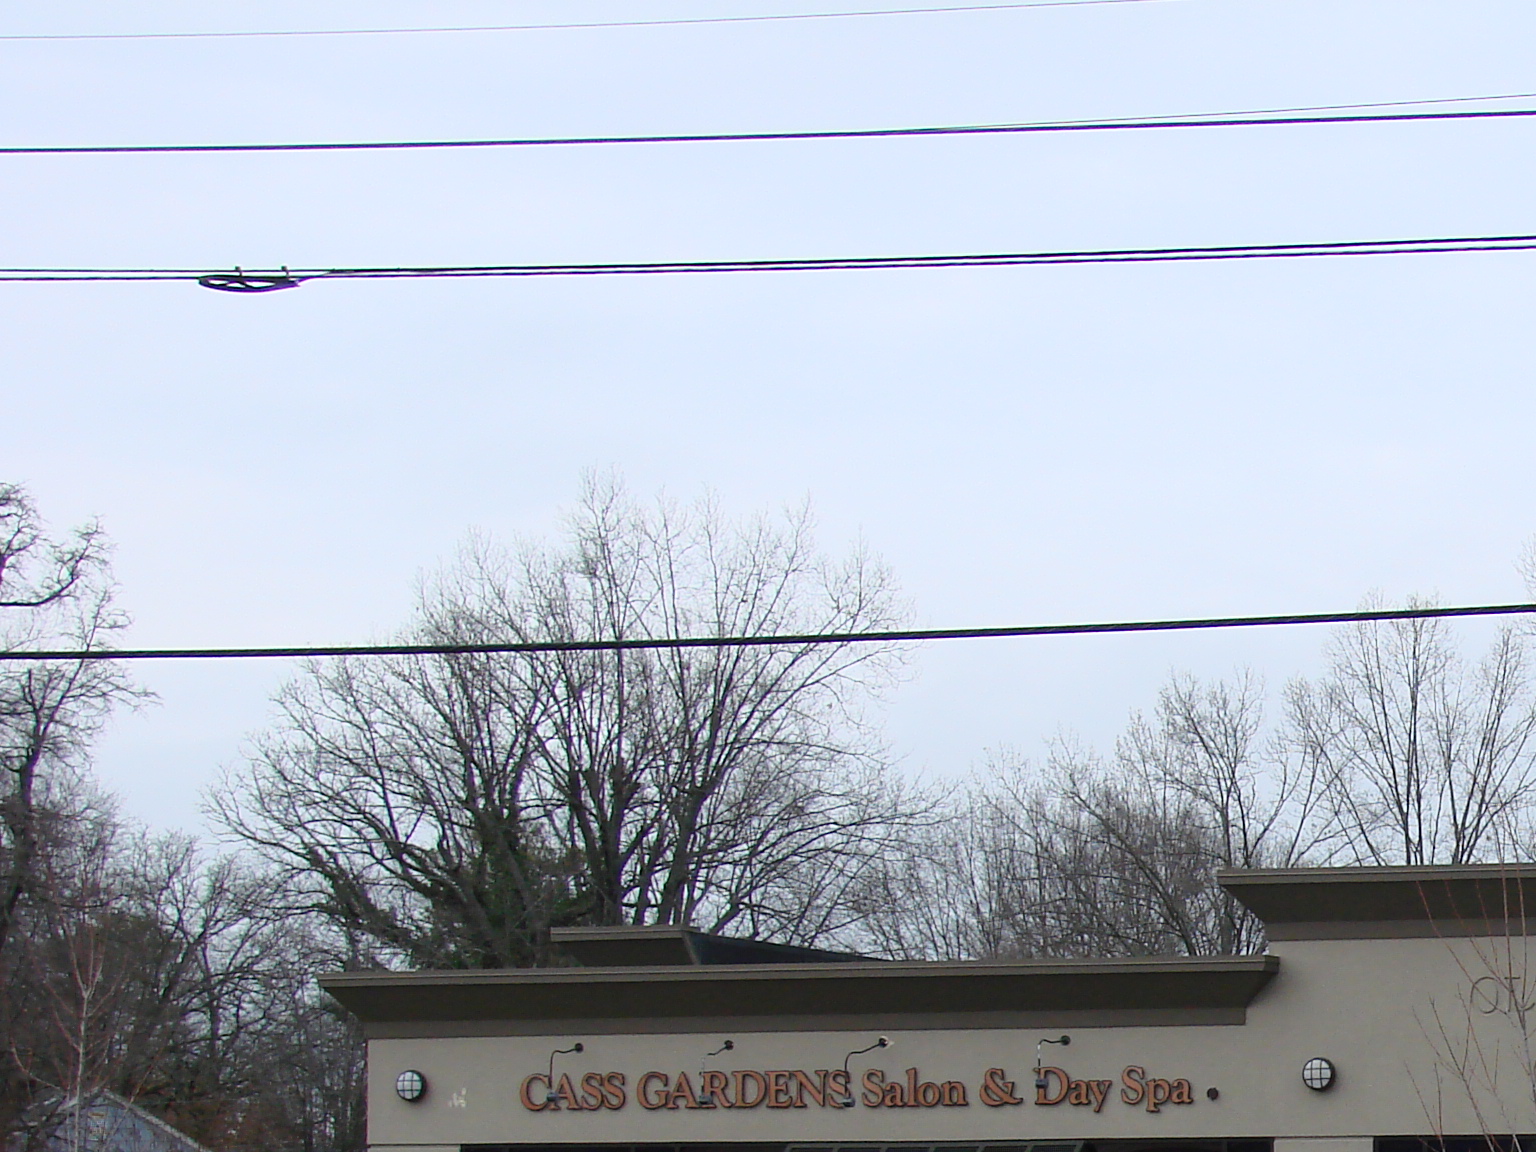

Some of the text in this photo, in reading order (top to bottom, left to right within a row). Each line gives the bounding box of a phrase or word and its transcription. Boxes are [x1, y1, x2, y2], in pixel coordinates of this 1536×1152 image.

[519, 1065, 1194, 1113] CASS GARDENS Salon & Day Spa
